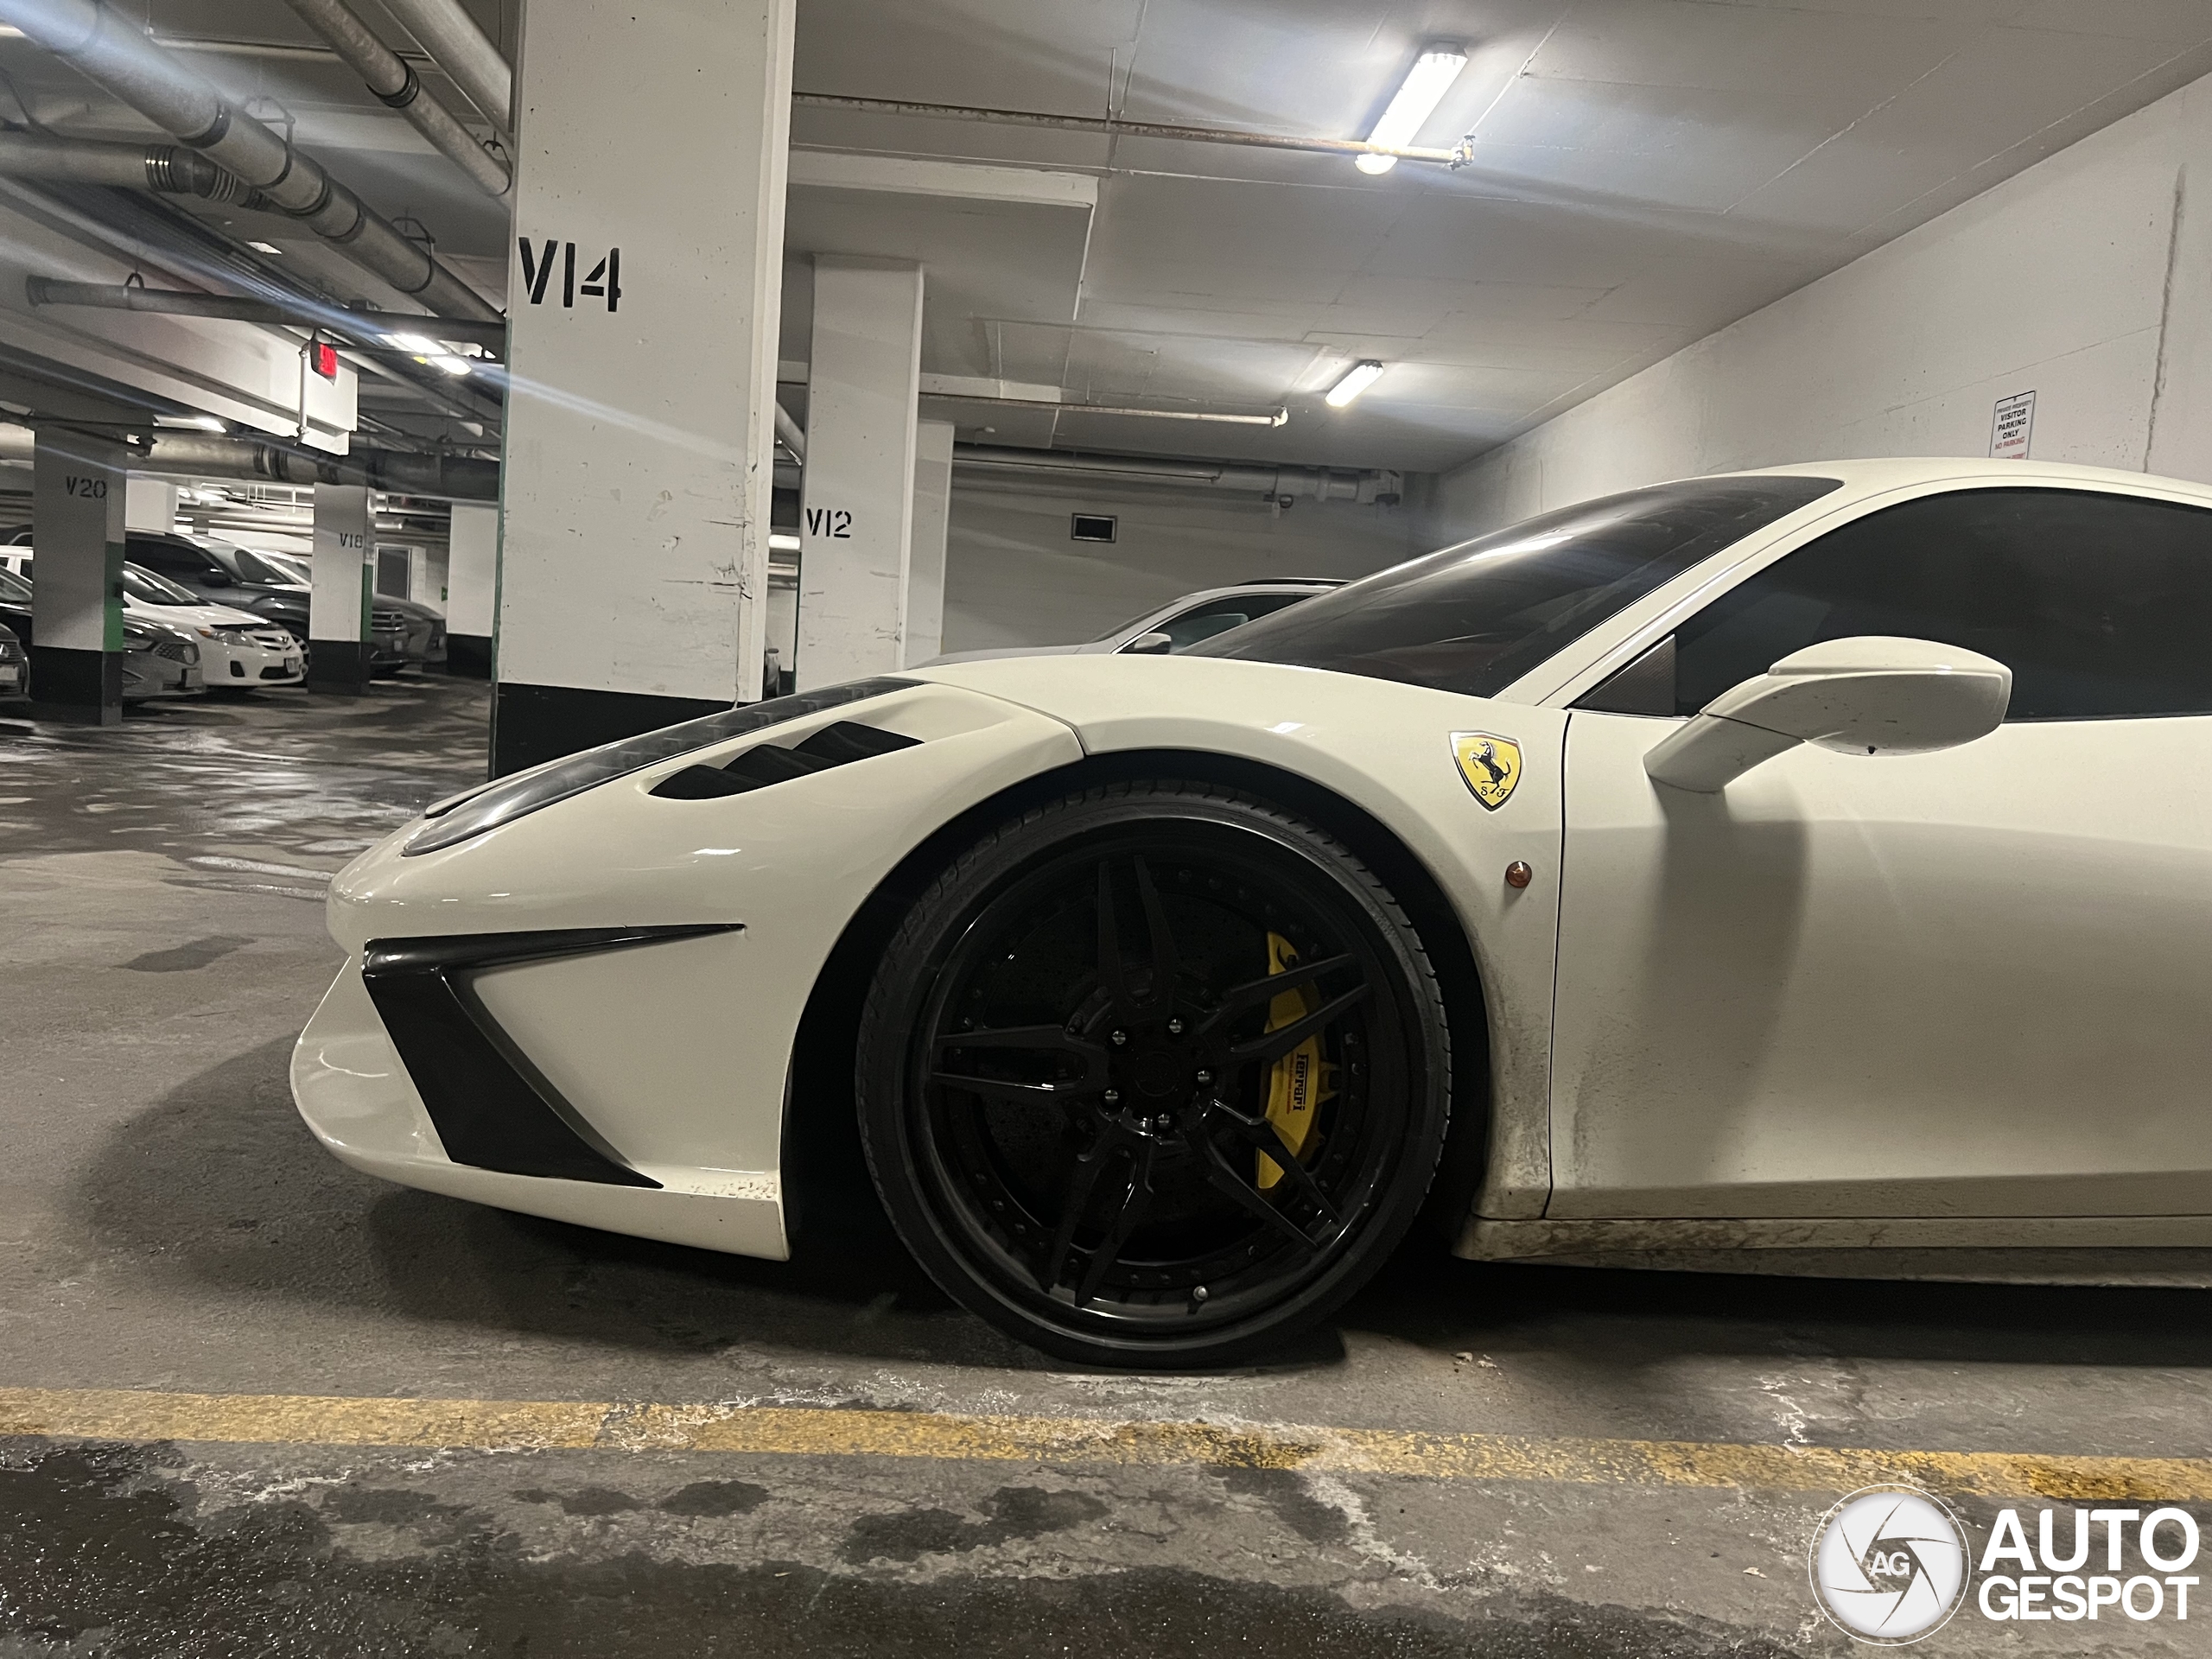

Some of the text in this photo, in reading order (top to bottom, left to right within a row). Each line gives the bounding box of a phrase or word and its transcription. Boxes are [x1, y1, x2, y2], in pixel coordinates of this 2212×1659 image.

[518, 237, 621, 312] V14
[2000, 408, 2026, 421] VISITOR
[1998, 417, 2027, 431] PARKING
[2002, 429, 2019, 439] ONLY
[2003, 436, 2025, 448] PARKING
[67, 476, 106, 499] V20
[806, 508, 852, 538] V12
[340, 532, 363, 548] V18
[1480, 785, 1510, 798] S F
[1293, 1053, 1309, 1111] Ferrari
